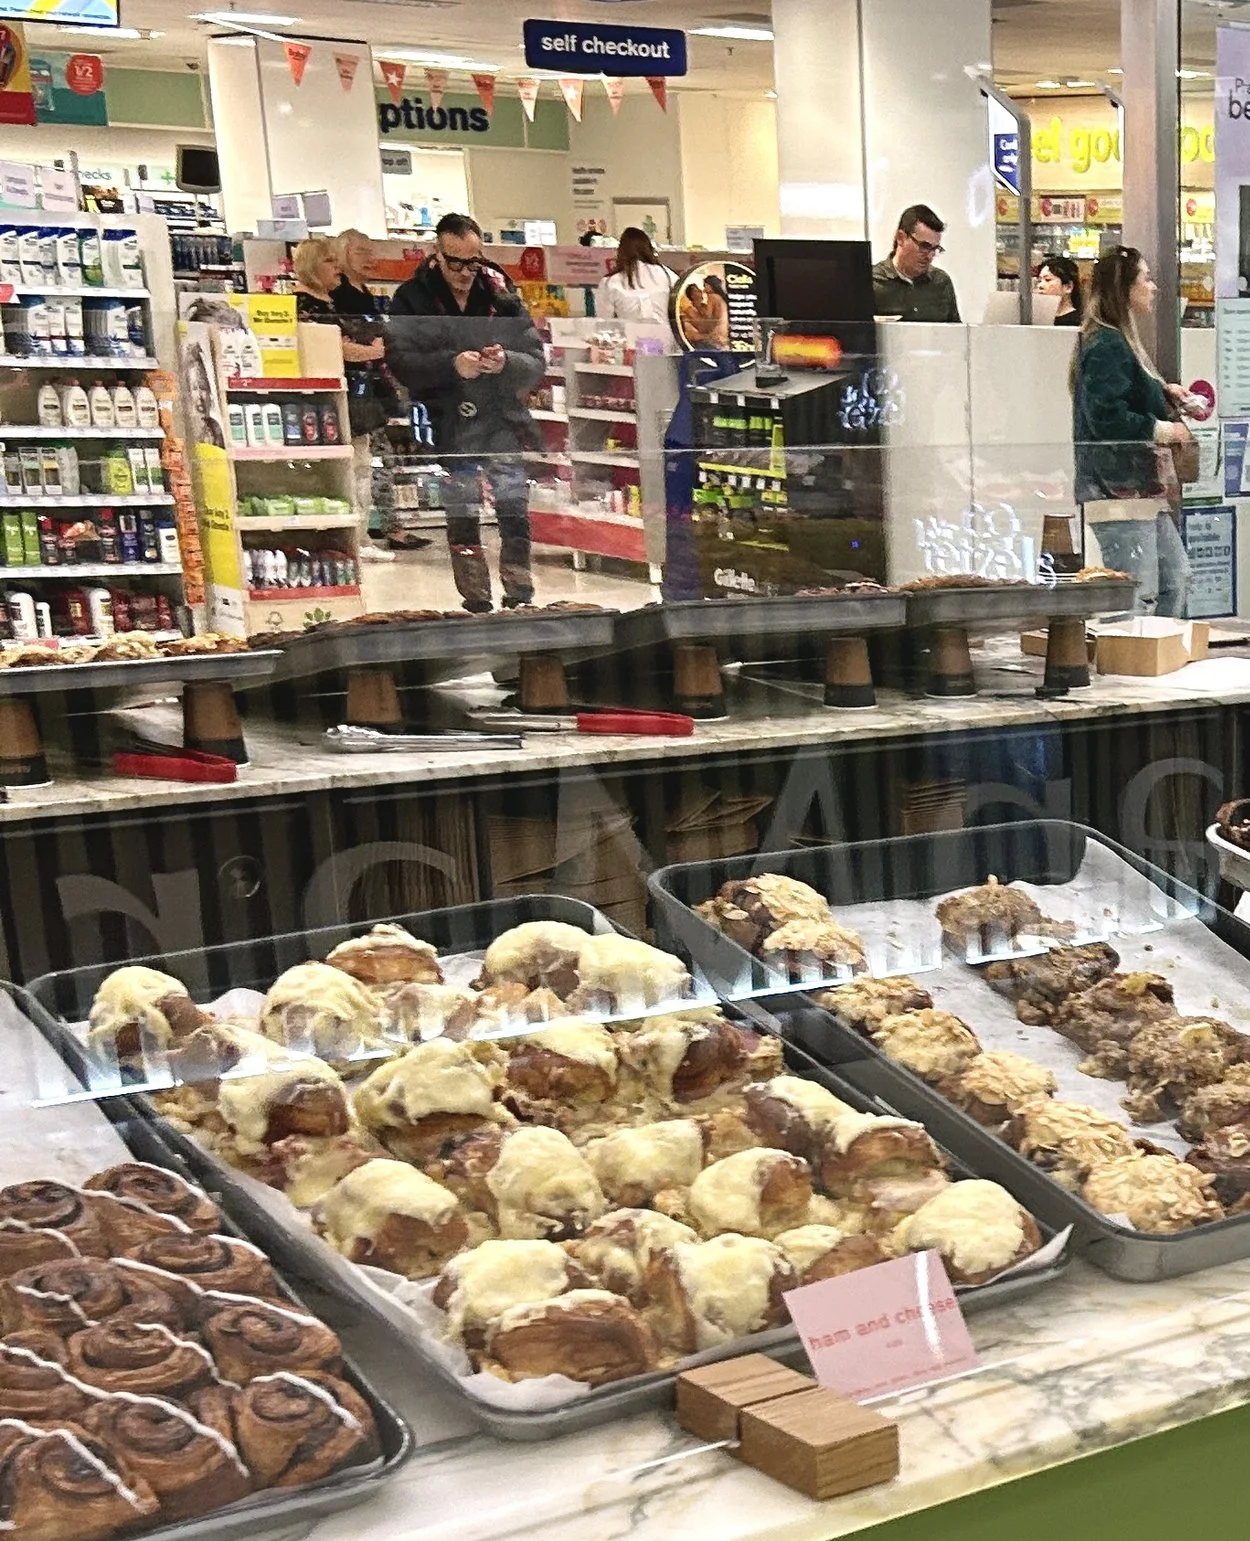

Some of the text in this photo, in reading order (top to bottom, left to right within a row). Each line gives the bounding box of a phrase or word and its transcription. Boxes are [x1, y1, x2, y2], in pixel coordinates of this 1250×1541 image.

[540, 33, 672, 59] self checkout
[807, 1328, 851, 1351] ham
[855, 1313, 891, 1336] and
